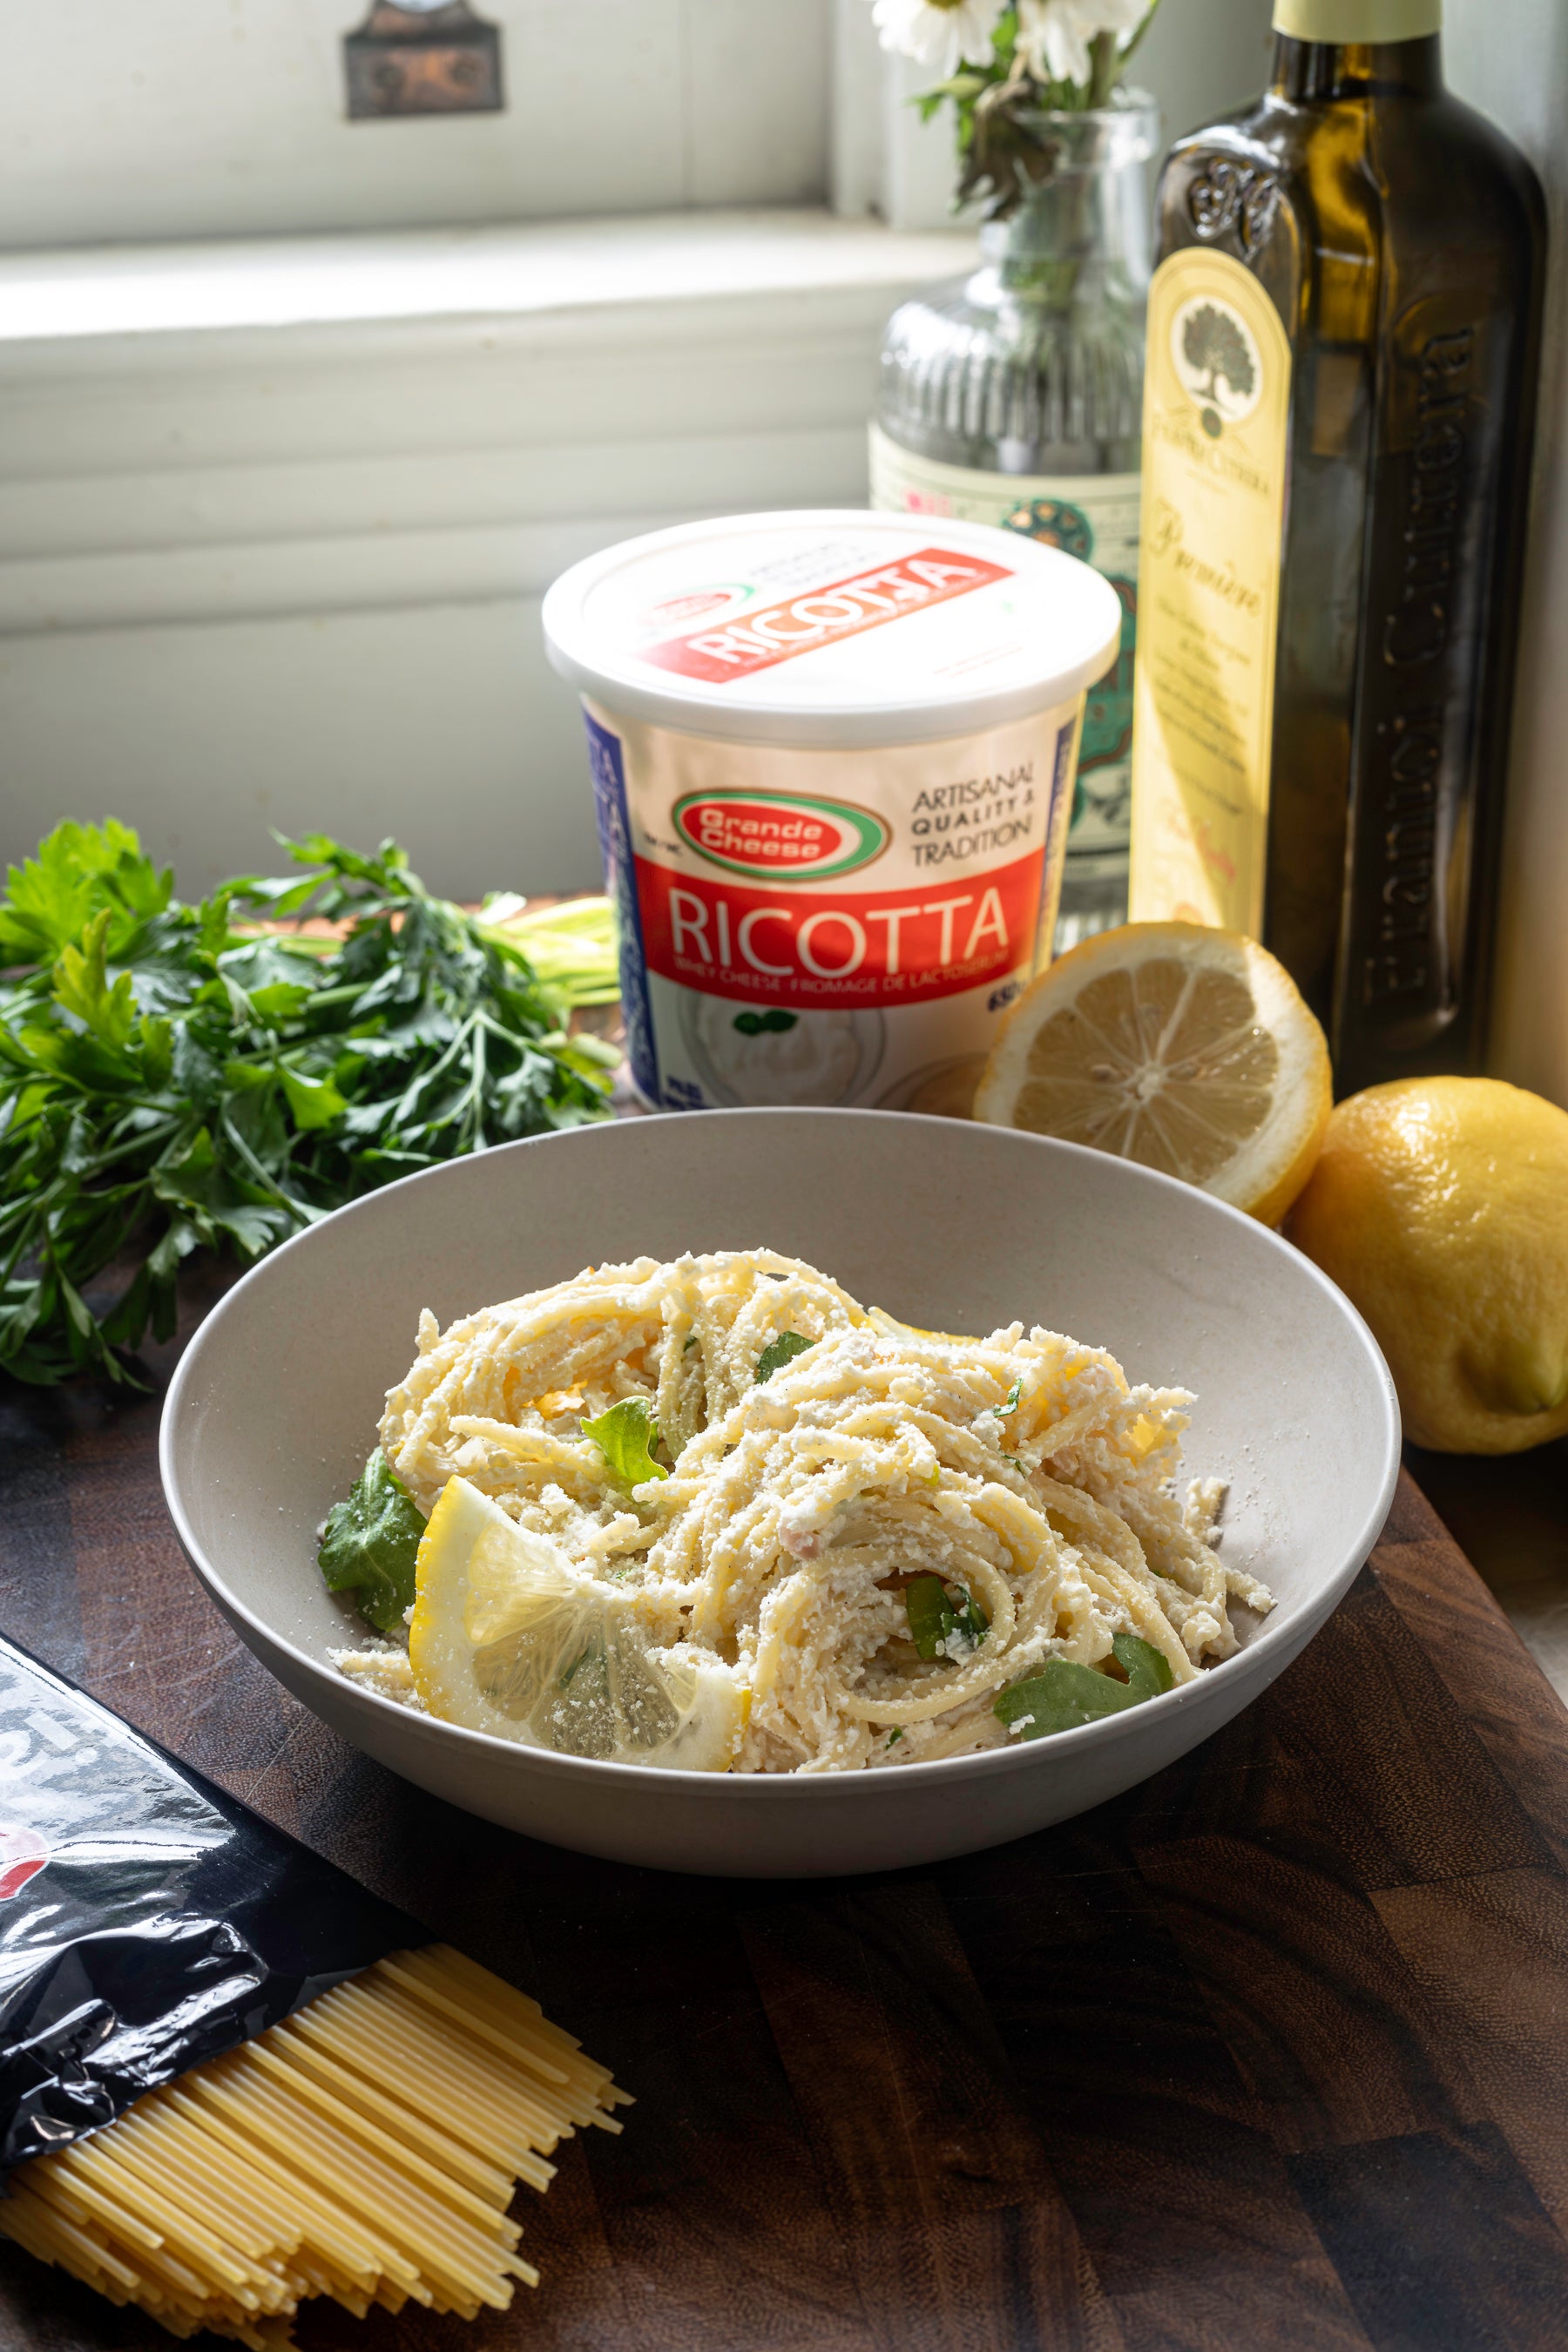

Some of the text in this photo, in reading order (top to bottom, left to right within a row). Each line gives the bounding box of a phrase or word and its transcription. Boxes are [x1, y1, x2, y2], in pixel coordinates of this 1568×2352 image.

[686, 558, 979, 665] RICOTTA
[912, 761, 1033, 814] ARTISANAL
[700, 808, 823, 841] Grande
[911, 794, 1017, 836] QUALITY
[700, 827, 821, 859] Cheese
[912, 813, 1033, 868] TRADITION
[669, 886, 1009, 979] RICOTTA
[720, 969, 781, 992] CHEESE
[790, 977, 877, 994] FROMAGE
[882, 974, 906, 991] DE
